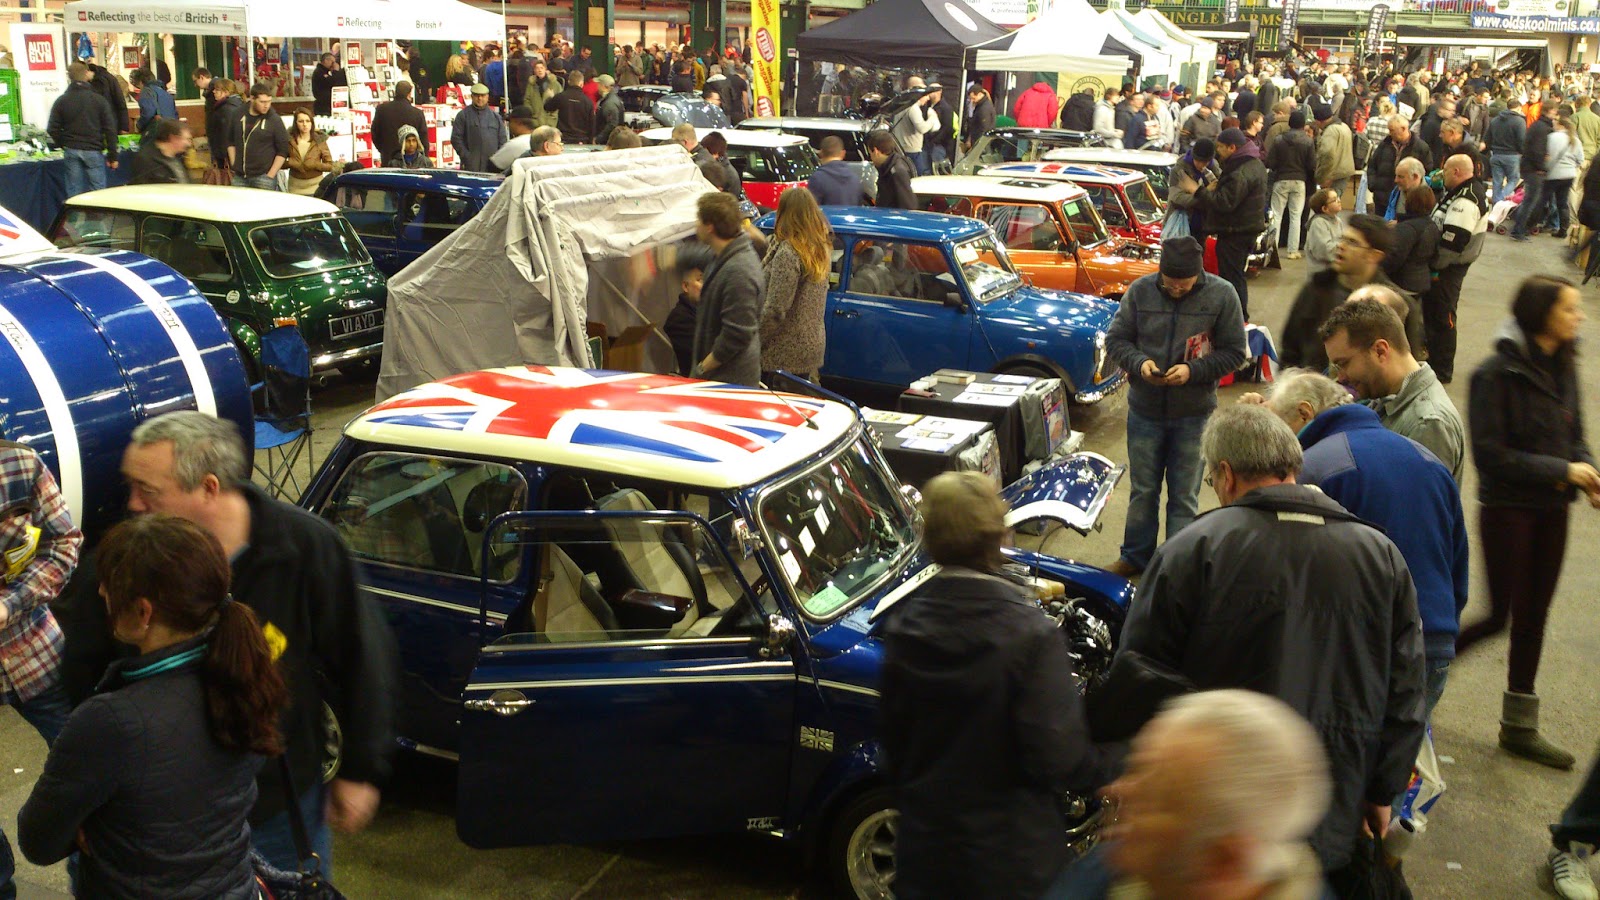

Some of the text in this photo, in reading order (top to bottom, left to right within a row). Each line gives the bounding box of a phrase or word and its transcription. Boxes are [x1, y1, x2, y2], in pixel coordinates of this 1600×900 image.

[88, 11, 219, 24] Reflecting the best of British
[345, 17, 382, 30] Reflecting
[415, 20, 437, 29] British
[28, 41, 51, 52] AUTO
[757, 29, 774, 61] mini
[757, 60, 773, 96] magazine
